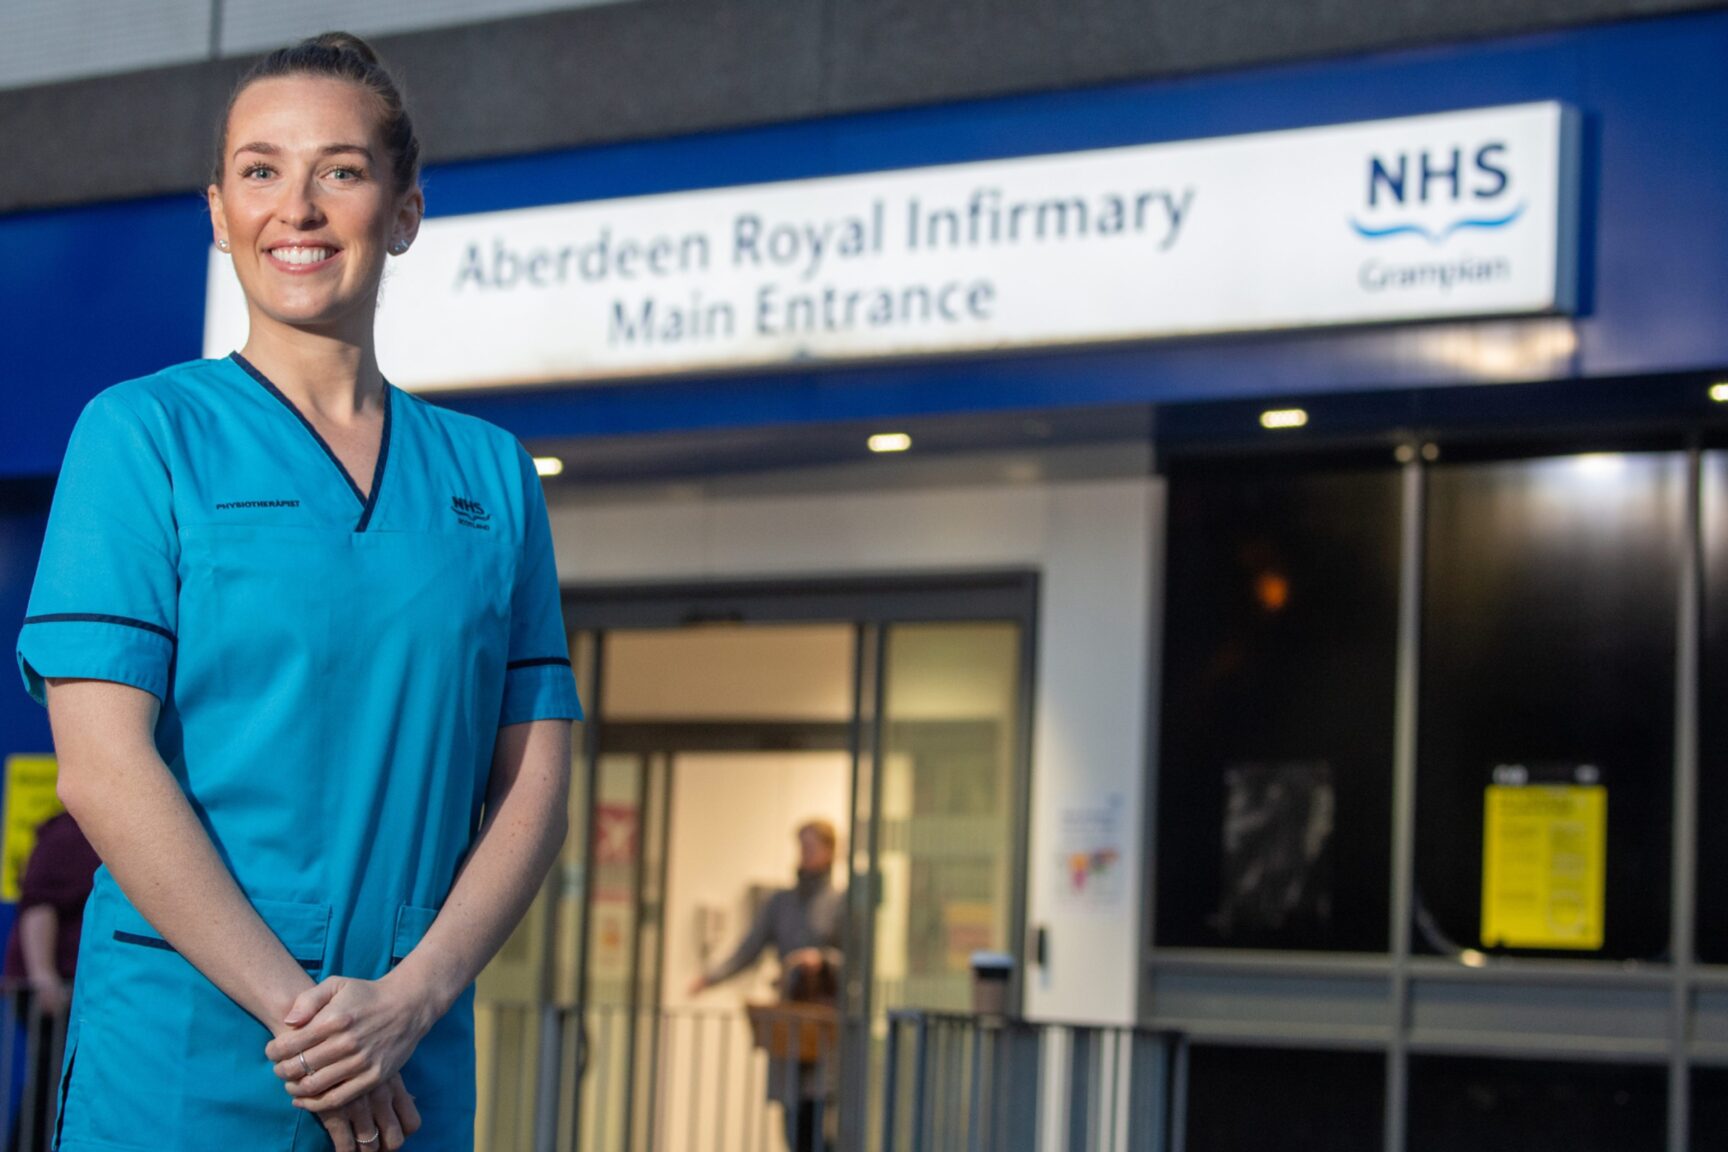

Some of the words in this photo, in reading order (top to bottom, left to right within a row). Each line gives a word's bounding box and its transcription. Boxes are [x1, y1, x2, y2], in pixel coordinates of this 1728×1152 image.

[1368, 142, 1508, 207] NHS
[458, 229, 707, 290] Aberdeen
[734, 201, 884, 279] Royal
[909, 188, 1195, 252] Infirmary
[1359, 256, 1510, 293] Grampian
[611, 290, 732, 346] Main
[758, 279, 994, 336] Entrance
[216, 500, 300, 510] PHYSIOTHERAPIST
[452, 496, 484, 515] NHS
